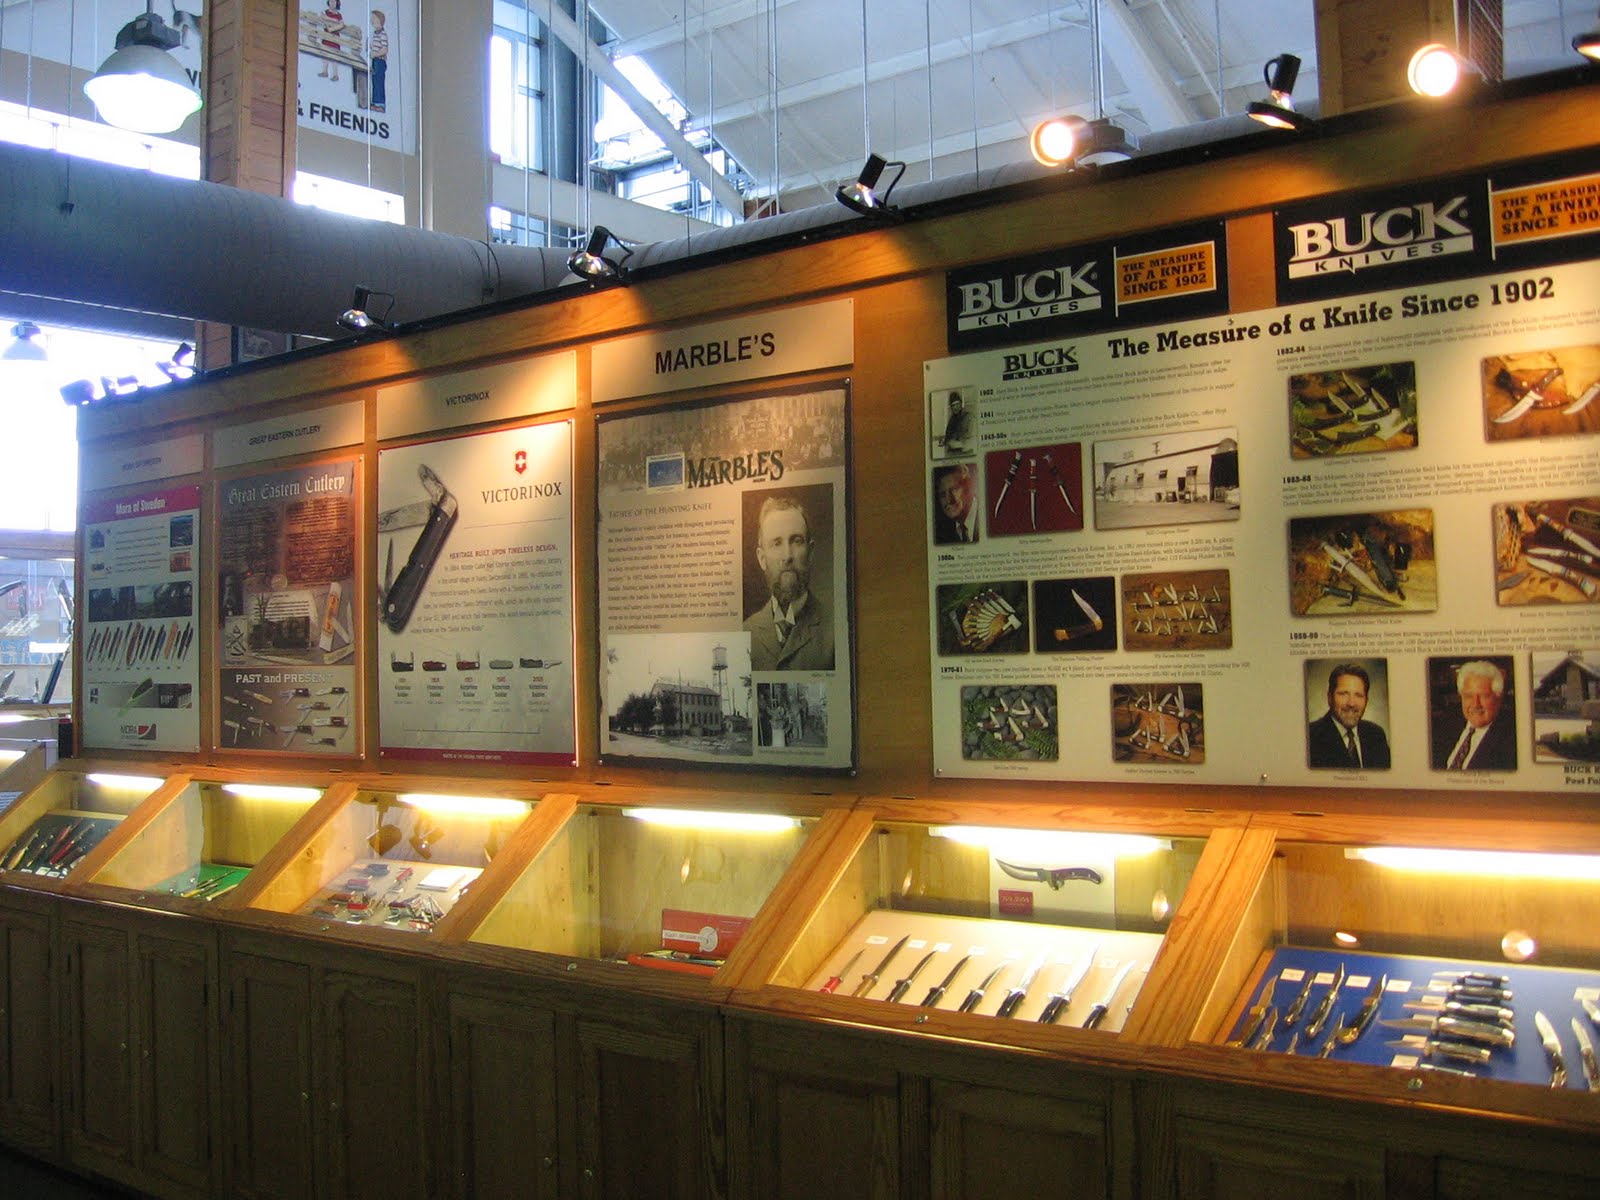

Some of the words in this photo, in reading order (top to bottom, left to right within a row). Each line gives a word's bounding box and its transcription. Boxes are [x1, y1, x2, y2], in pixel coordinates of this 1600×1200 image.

[310, 102, 390, 140] FRIENDS
[1502, 196, 1528, 208] THE
[1535, 184, 1600, 202] MEASUR
[1502, 208, 1524, 220] OF
[1532, 205, 1542, 216] A
[1550, 195, 1600, 213] KNIF
[1288, 197, 1472, 261] BUCK
[1502, 216, 1558, 234] SINCE
[1570, 210, 1600, 224] 190
[1122, 262, 1146, 273] THE
[1149, 251, 1206, 268] MEASURE
[1315, 242, 1444, 274] KNIVES
[1122, 272, 1142, 283] OF
[1146, 269, 1158, 280] A
[1160, 262, 1206, 278] KNIFE
[958, 261, 1100, 317] BUCK
[1123, 280, 1168, 296] SINCE
[1176, 273, 1207, 288] 1902
[978, 301, 1080, 328] KNIVES
[1108, 339, 1150, 358] The
[1156, 324, 1260, 352] Measure
[1268, 314, 1292, 336] of
[1300, 314, 1317, 332] a
[1322, 298, 1394, 329] Knife
[1401, 292, 1480, 318] Since
[1490, 276, 1555, 307] 1902
[655, 332, 776, 374] MARBLE'S
[1003, 346, 1078, 373] BUCK
[1013, 366, 1068, 380] KNIVES
[446, 390, 490, 406] VICTORINOX
[250, 434, 266, 446] GREAT
[268, 430, 294, 443] EASTERN
[294, 425, 321, 438] CUTLERY
[228, 488, 257, 504] Great
[260, 482, 300, 500] Eastern
[304, 473, 345, 493] Cutlery
[482, 482, 562, 504] VICTORINOX
[116, 503, 132, 515] Mora
[132, 501, 140, 512] of
[141, 498, 166, 512] Sweden
[645, 507, 657, 515] THE
[658, 504, 691, 514] HUNTING
[692, 502, 712, 511] KNIFE
[450, 550, 474, 560] HERITAGE
[475, 549, 490, 557] BUILT
[492, 548, 506, 556] UPON
[508, 546, 534, 554] TIMELESS
[236, 674, 262, 684] PAST
[264, 673, 282, 683] and
[284, 673, 333, 683] PRESENT
[1564, 766, 1591, 774] BUCK
